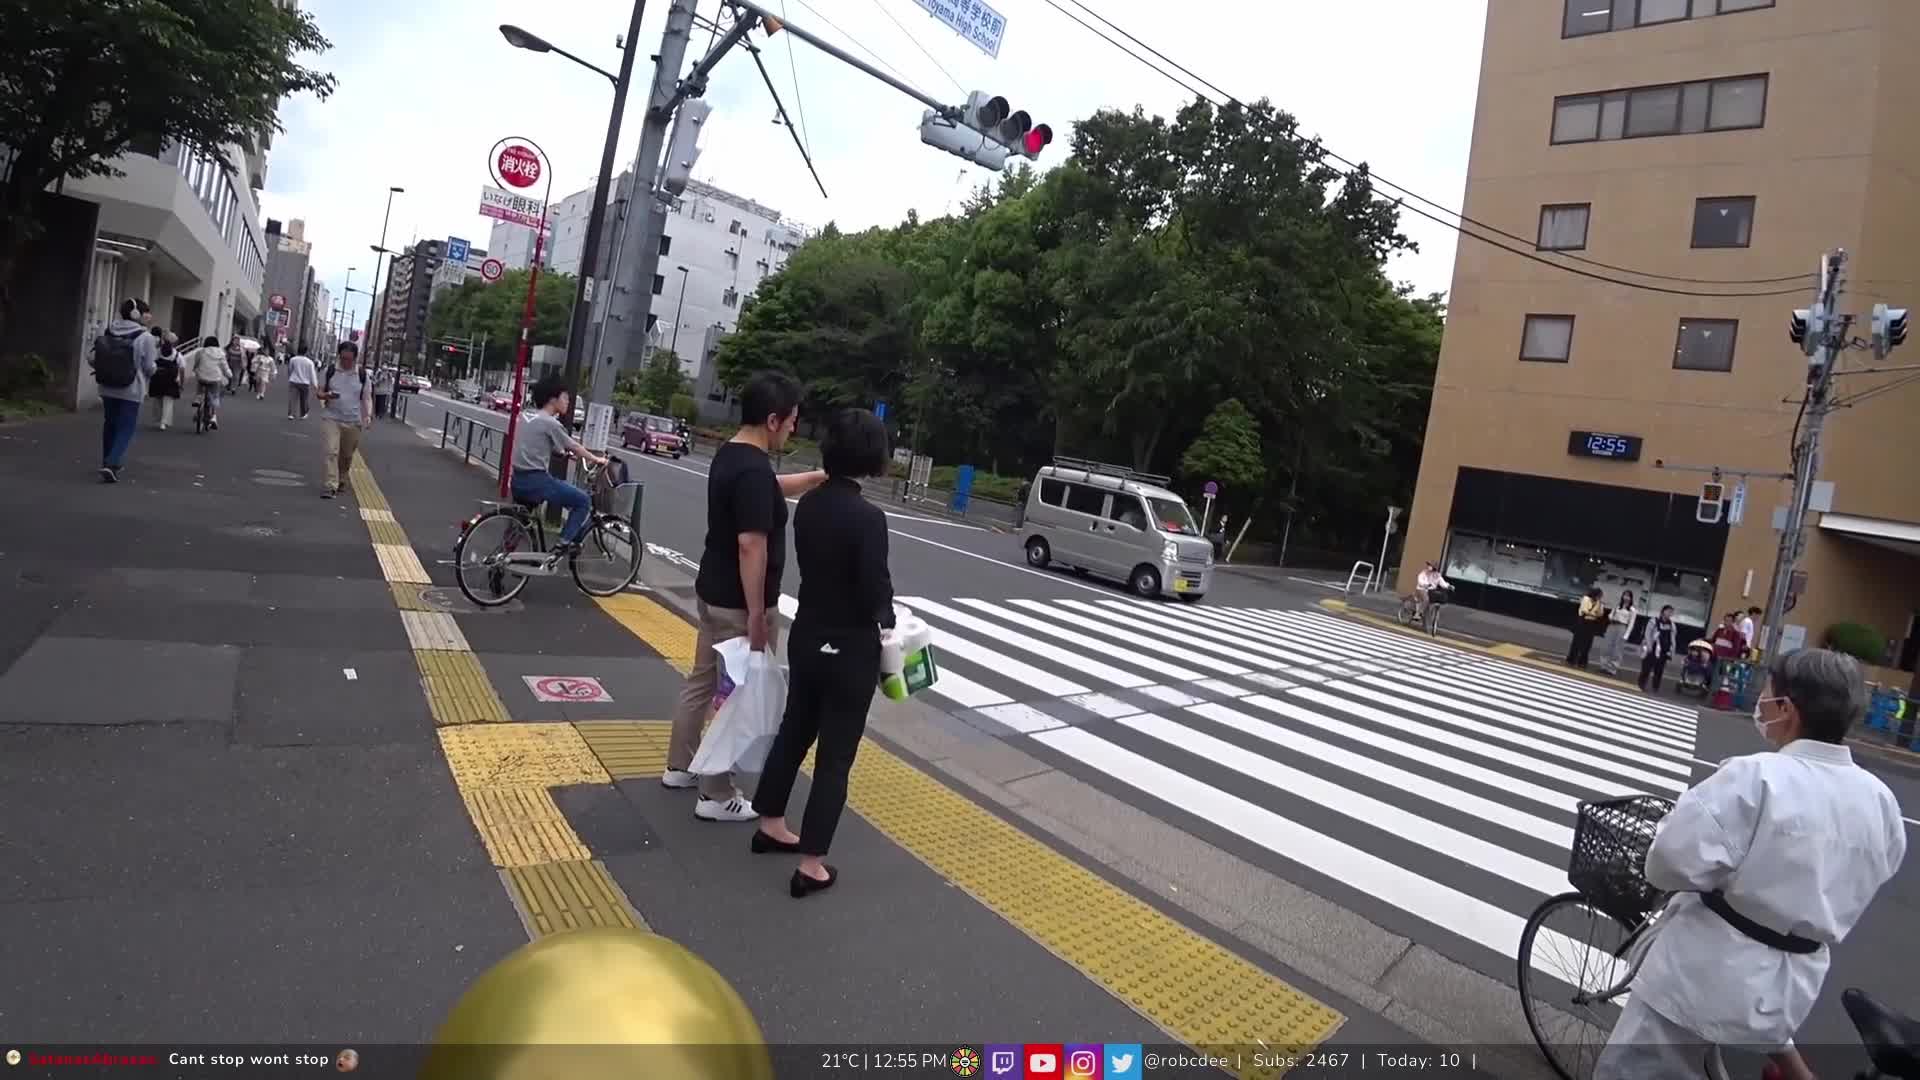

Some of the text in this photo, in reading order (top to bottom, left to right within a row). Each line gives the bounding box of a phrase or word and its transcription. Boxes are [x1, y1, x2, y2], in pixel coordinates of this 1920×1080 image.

[955, 13, 972, 34] High
[972, 25, 997, 52] School
[501, 155, 538, 180] 消火栓
[483, 191, 540, 215] いなげ眼科
[1587, 436, 1627, 453] 12:55
